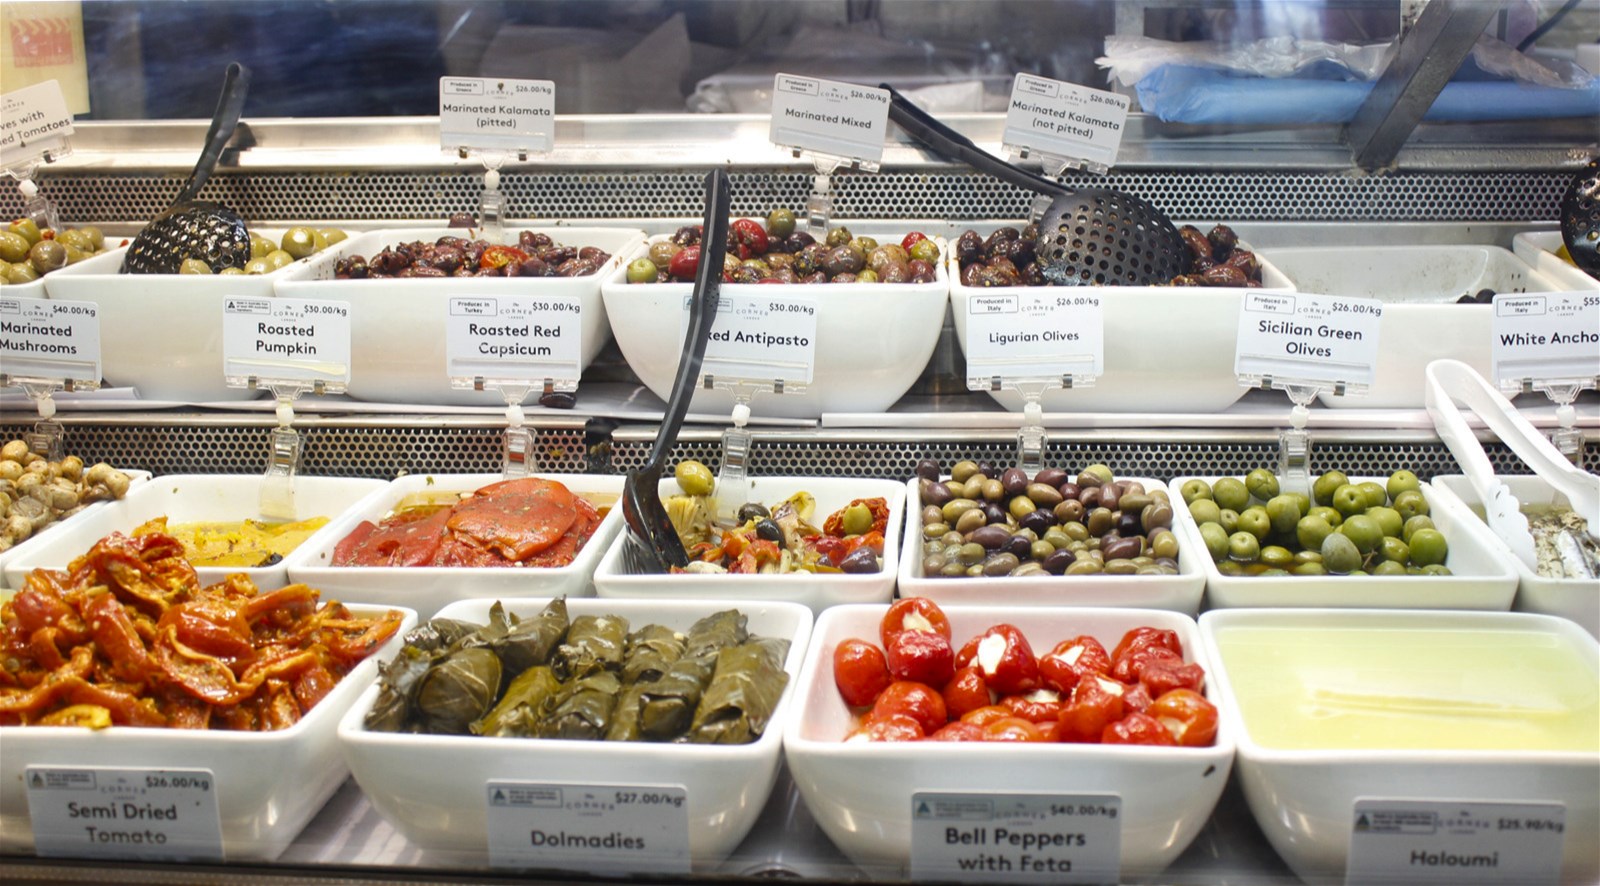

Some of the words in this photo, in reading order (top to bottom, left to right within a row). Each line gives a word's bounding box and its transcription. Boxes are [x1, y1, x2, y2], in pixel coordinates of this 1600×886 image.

[516, 85, 552, 95] $26.00/kg
[850, 90, 887, 103] $26.00/kg
[1089, 94, 1126, 109] $26.00/kg
[19, 111, 45, 124] with
[443, 104, 496, 114] Marinated
[499, 105, 551, 116] Kalamata
[1012, 100, 1066, 119] Marinated
[1068, 112, 1120, 130] Kalamata
[476, 118, 517, 129] (pitted)
[785, 108, 839, 124] Marinated
[841, 116, 872, 129] Mixed
[16, 119, 70, 139] Tomatoes
[1032, 118, 1055, 130] (not
[1056, 123, 1094, 139] pitted)
[532, 301, 581, 314] $30.00/kg
[1056, 297, 1099, 307] $26.00/kg
[1253, 296, 1281, 304] Produced
[52, 305, 96, 317] $40.00/kg
[304, 304, 347, 317] $30.00/kg
[769, 302, 815, 316] $30.00/kg
[1297, 307, 1331, 315] CORNER
[1332, 302, 1382, 317] $26.00/kg
[0, 321, 72, 337] Marinated
[258, 322, 315, 337] Roasted
[469, 323, 529, 337] Roasted
[534, 325, 561, 337] Red
[1258, 320, 1313, 336] Sicilian
[1317, 325, 1362, 340] Green
[708, 330, 730, 342] xed
[734, 330, 809, 348] Antipasto
[989, 331, 1039, 346] Ligurian
[1042, 330, 1080, 341] Olives
[1500, 332, 1546, 346] White
[0, 339, 77, 355] Mushrooms
[256, 340, 317, 357] Pumpkin
[478, 342, 551, 358] Capsicum
[1285, 341, 1332, 357] Olives
[145, 776, 209, 791] $26.00/kg
[615, 791, 682, 808] $27.00/kg
[68, 801, 117, 819] Semi
[122, 803, 177, 821] Dried
[1051, 804, 1117, 819] $40.00/kg
[85, 825, 167, 844] Tomato
[530, 829, 645, 850] Dolmadies
[945, 827, 986, 845] Bell
[994, 828, 1086, 851] Peppers
[958, 854, 1012, 872] with
[1021, 855, 1072, 872] Feta
[1409, 850, 1499, 868] Haloumi
